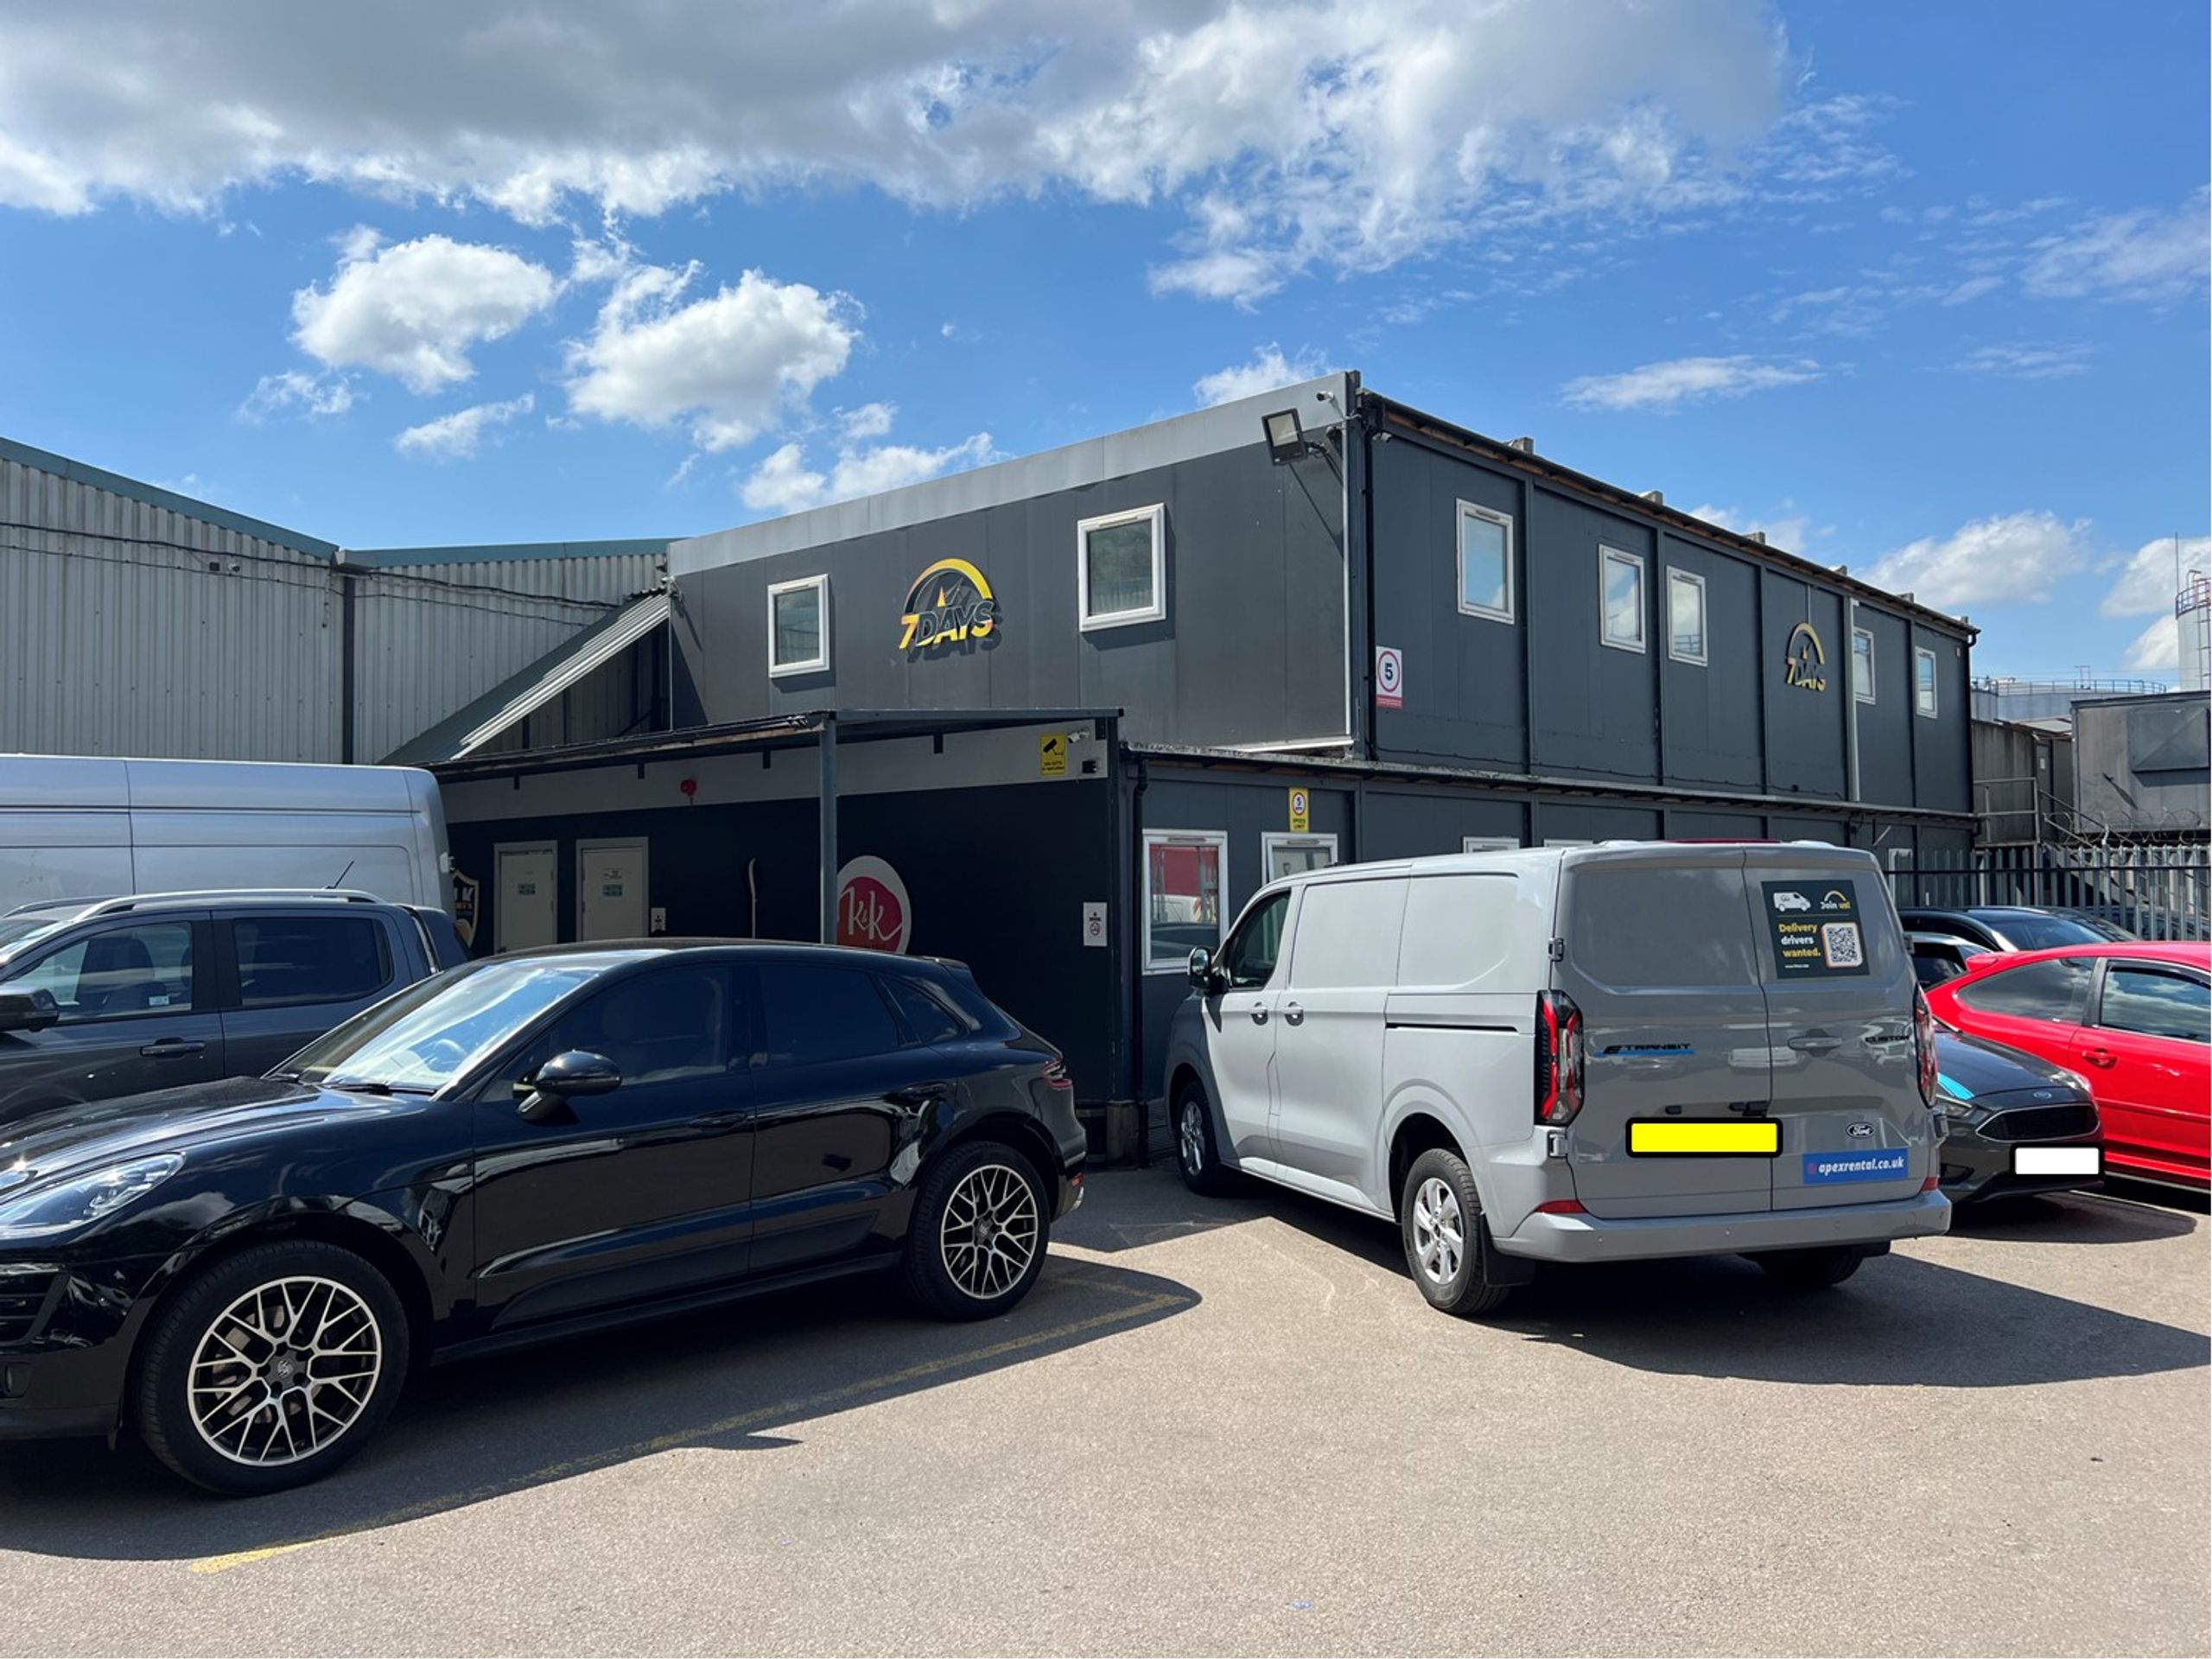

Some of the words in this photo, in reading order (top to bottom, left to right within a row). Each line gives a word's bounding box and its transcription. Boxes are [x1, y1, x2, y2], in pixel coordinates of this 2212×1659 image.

[1385, 662, 1394, 681] 5
[1820, 900, 1838, 910] Join
[1778, 922, 1818, 933] Delivery
[1781, 935, 1815, 945] drivers
[1783, 948, 1821, 958] wanted.
[1852, 1124, 1872, 1136] Ford
[1818, 1155, 1905, 1176] apexrental.co.uk
